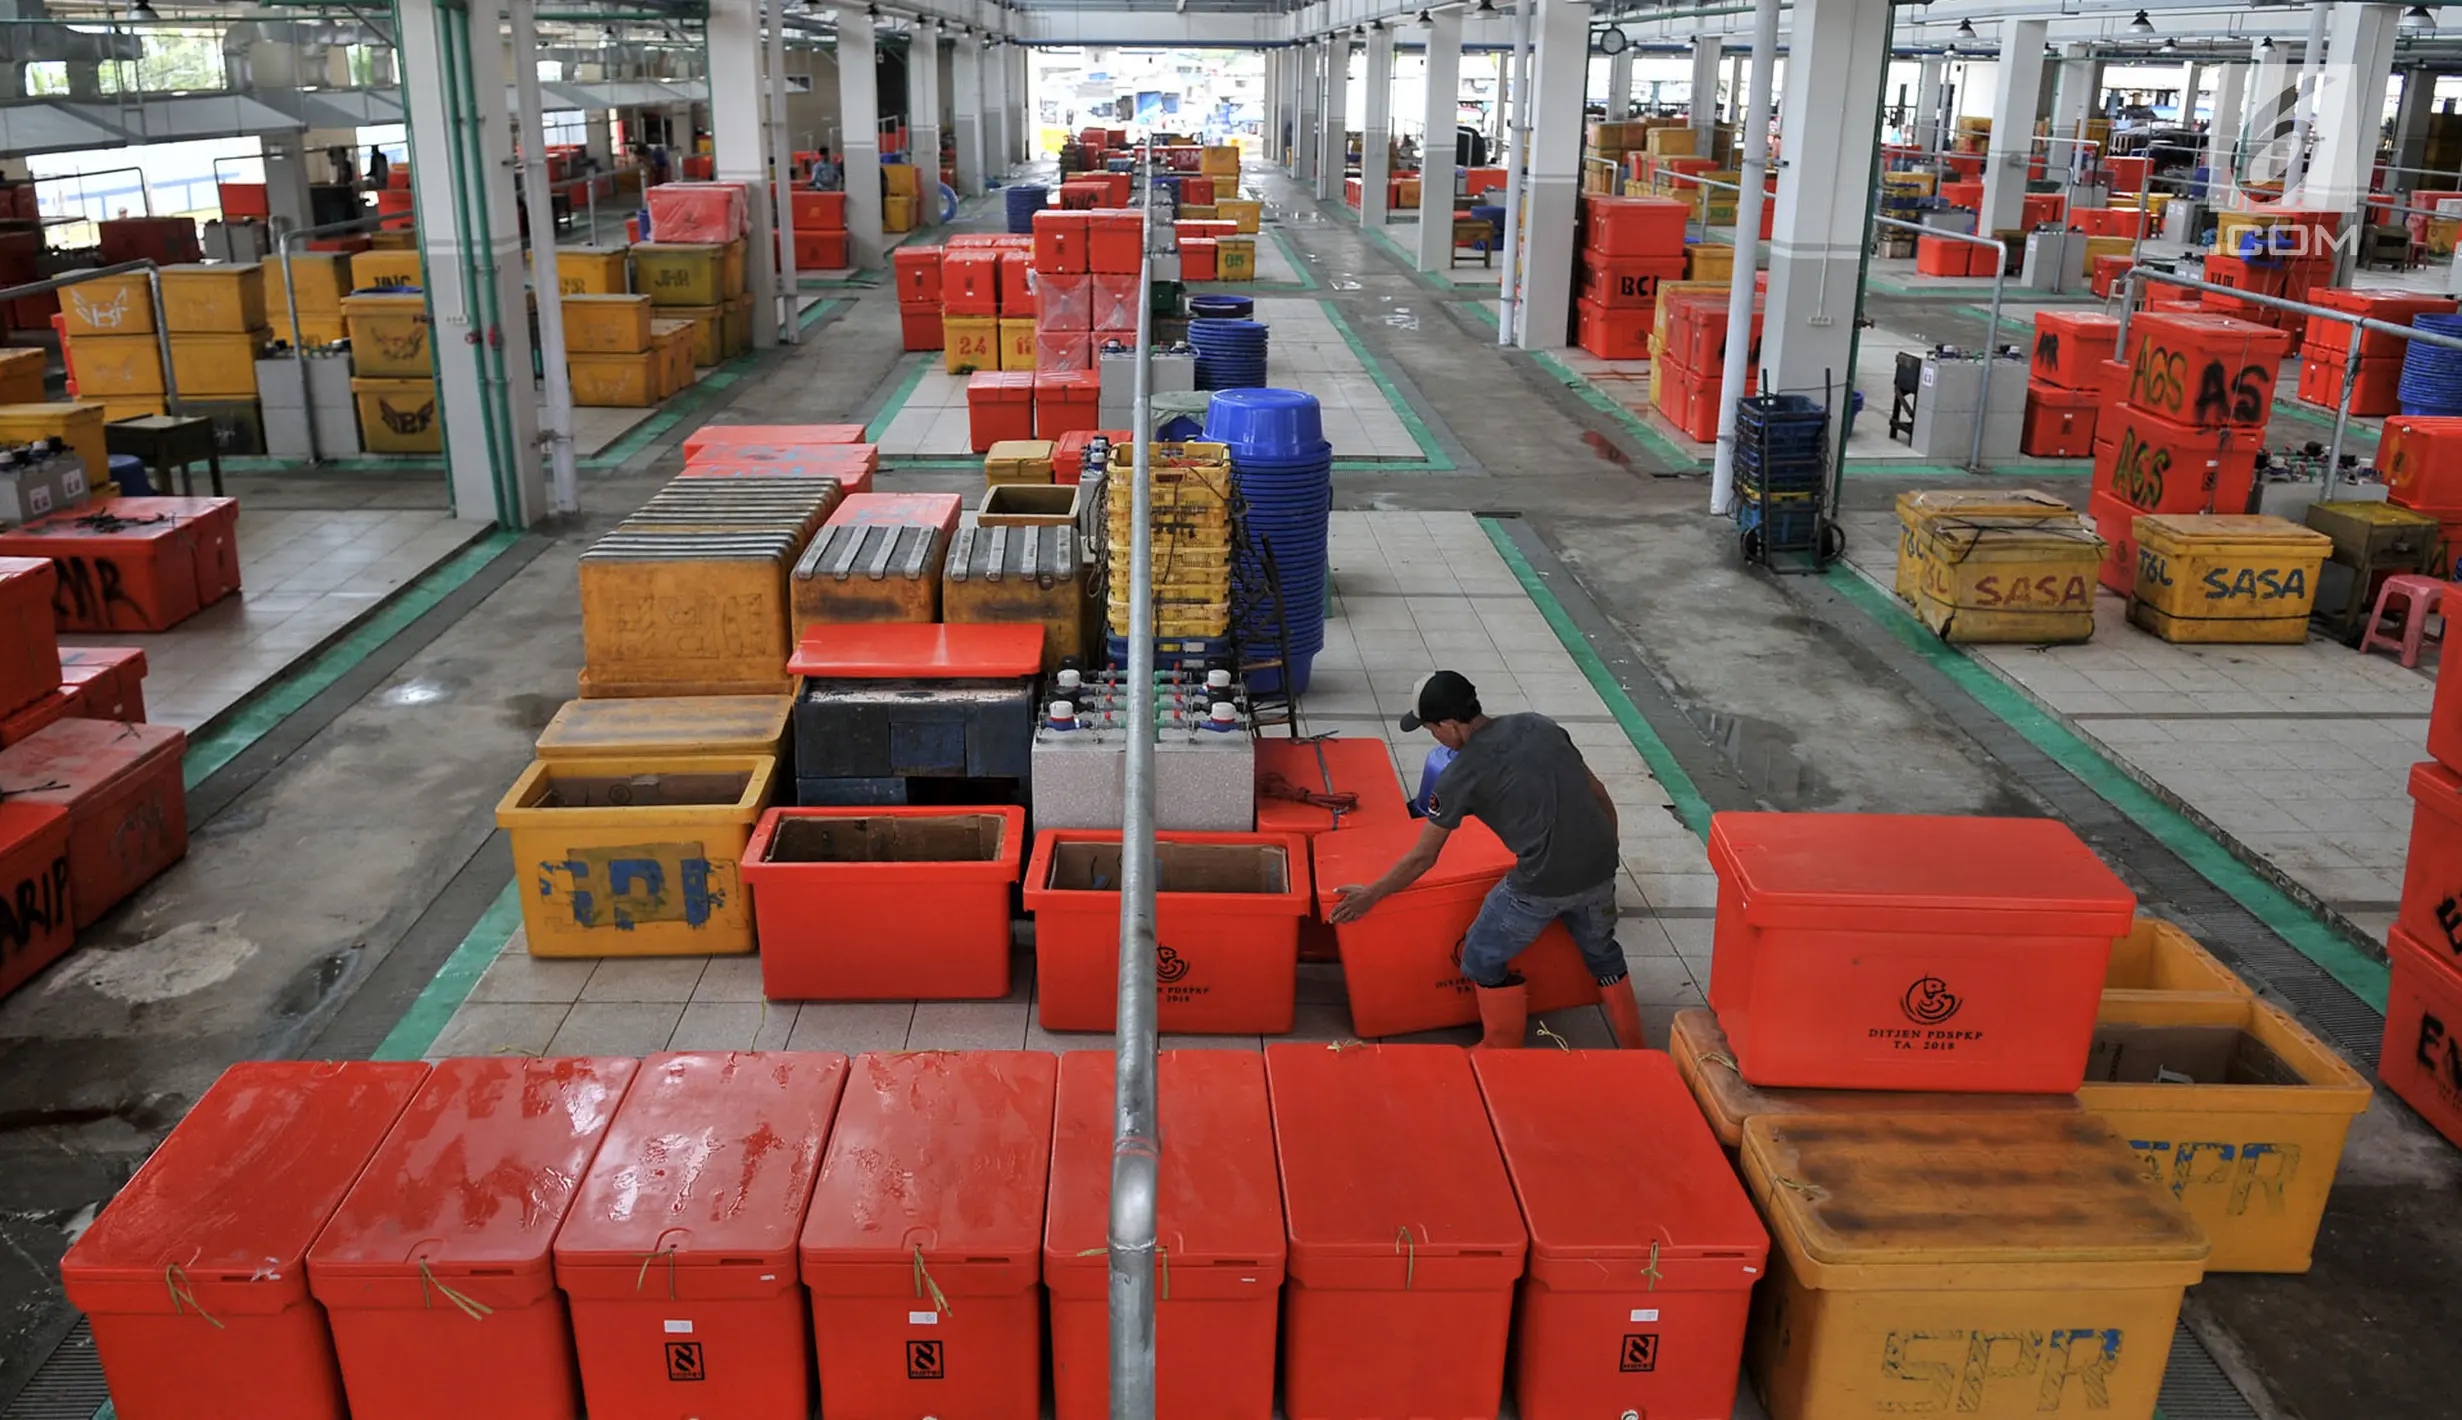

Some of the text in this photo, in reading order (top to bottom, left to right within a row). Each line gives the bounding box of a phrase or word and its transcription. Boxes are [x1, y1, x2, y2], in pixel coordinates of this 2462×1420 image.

[959, 337, 987, 356] 24
[2130, 334, 2188, 416] AGS
[2194, 358, 2270, 428] AS
[2112, 425, 2172, 510] AGS
[1974, 573, 2089, 607] SASA
[2203, 567, 2306, 600] SASA
[1868, 1028, 1984, 1040] DITJEN PDSPKP
[1923, 1041, 1955, 1050] 2018
[1876, 1328, 2124, 1414] SPR
